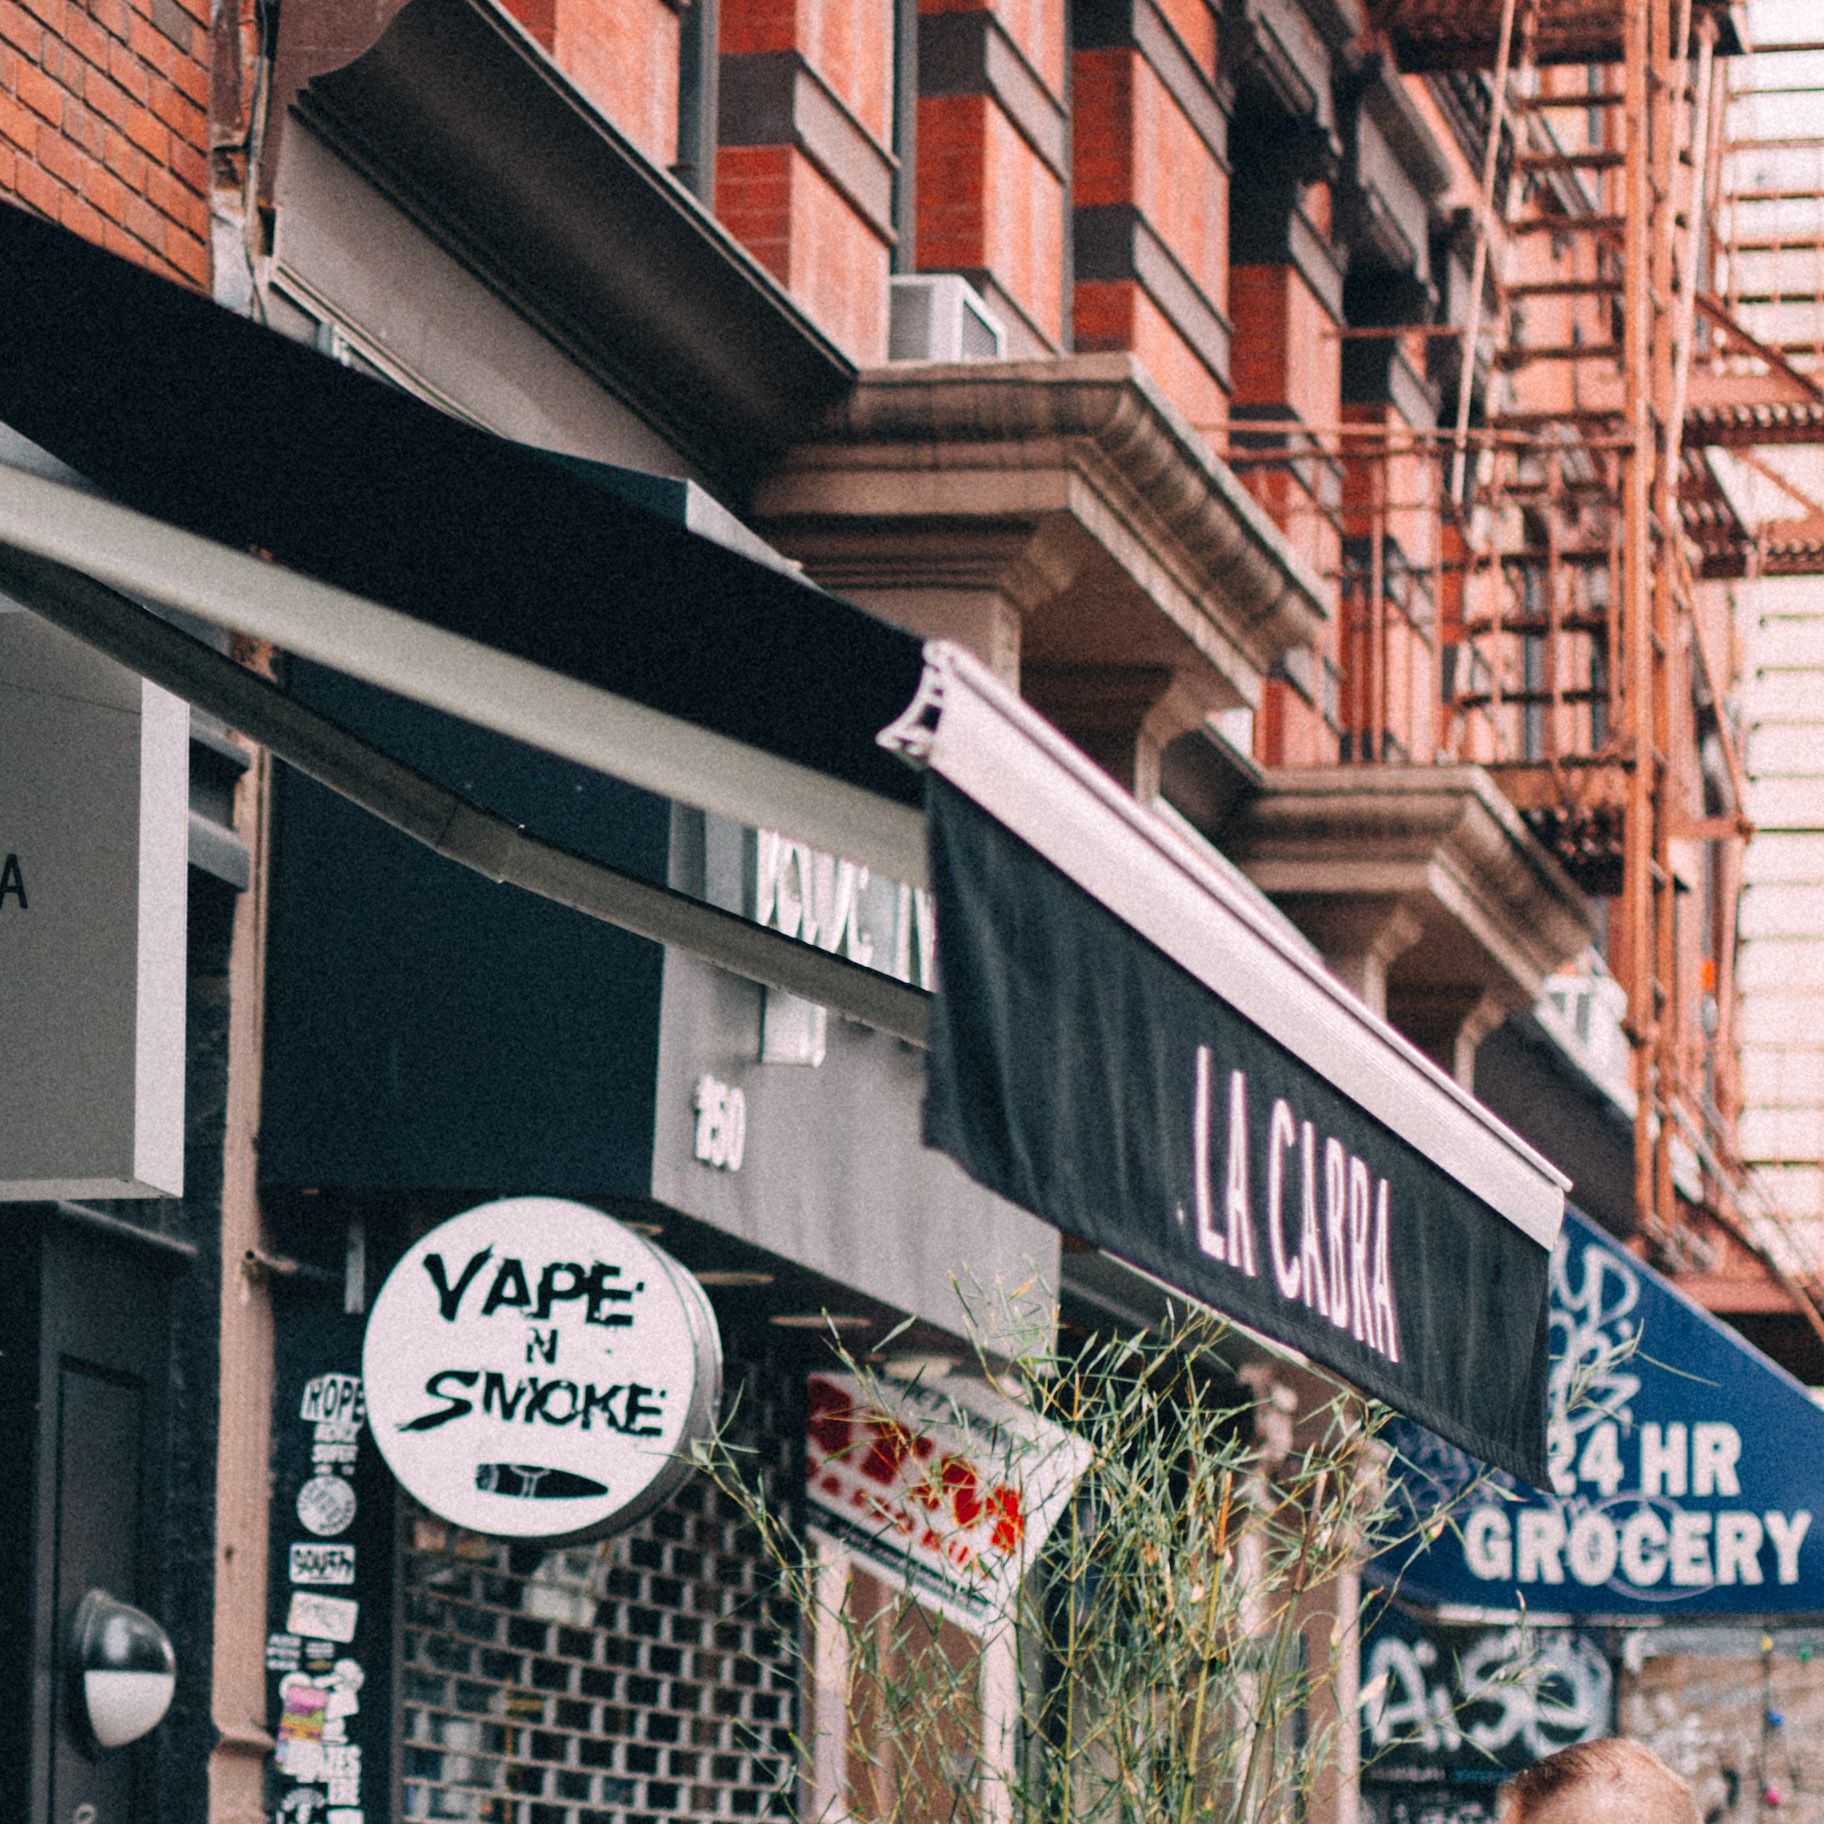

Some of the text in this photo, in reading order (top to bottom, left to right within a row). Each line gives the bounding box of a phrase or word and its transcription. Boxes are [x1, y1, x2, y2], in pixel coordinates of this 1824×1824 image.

[1192, 1044, 1257, 1279] LA
[1266, 1097, 1400, 1364] CABRA
[422, 1242, 645, 1328] VAPE
[525, 1328, 558, 1364] N
[394, 1369, 668, 1438] SMOKE
[1550, 1421, 1624, 1497] 24
[1640, 1421, 1742, 1497] HR
[1463, 1507, 1813, 1587] GROCERY
